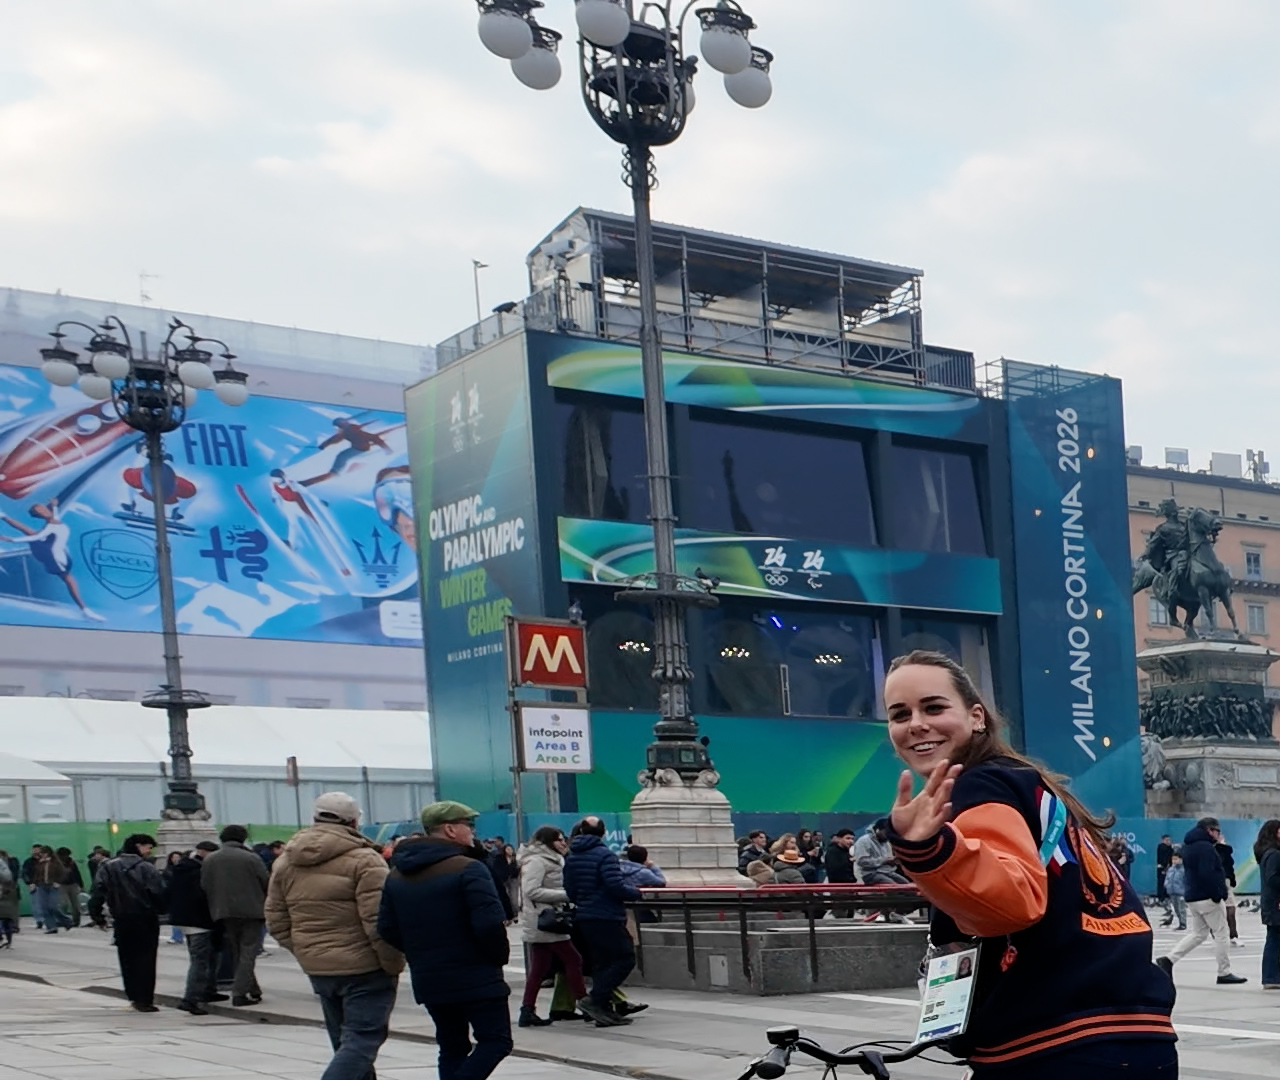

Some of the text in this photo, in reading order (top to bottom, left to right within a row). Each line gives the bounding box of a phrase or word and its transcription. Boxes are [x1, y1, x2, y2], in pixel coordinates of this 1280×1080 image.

[181, 423, 248, 467] FIAT
[429, 494, 483, 540] OLYMPIC
[443, 517, 525, 572] PARALYMPIC
[97, 552, 150, 568] LANCIA
[439, 568, 487, 609] WINTER
[1055, 407, 1097, 762] MILANO CORTINA 2026
[447, 643, 503, 663] MILANO CORTINA
[524, 633, 582, 674] M
[529, 727, 583, 739] infopoint
[535, 741, 580, 751] Area B
[535, 753, 581, 764] Area C
[1085, 916, 1143, 932] AIM HIG
